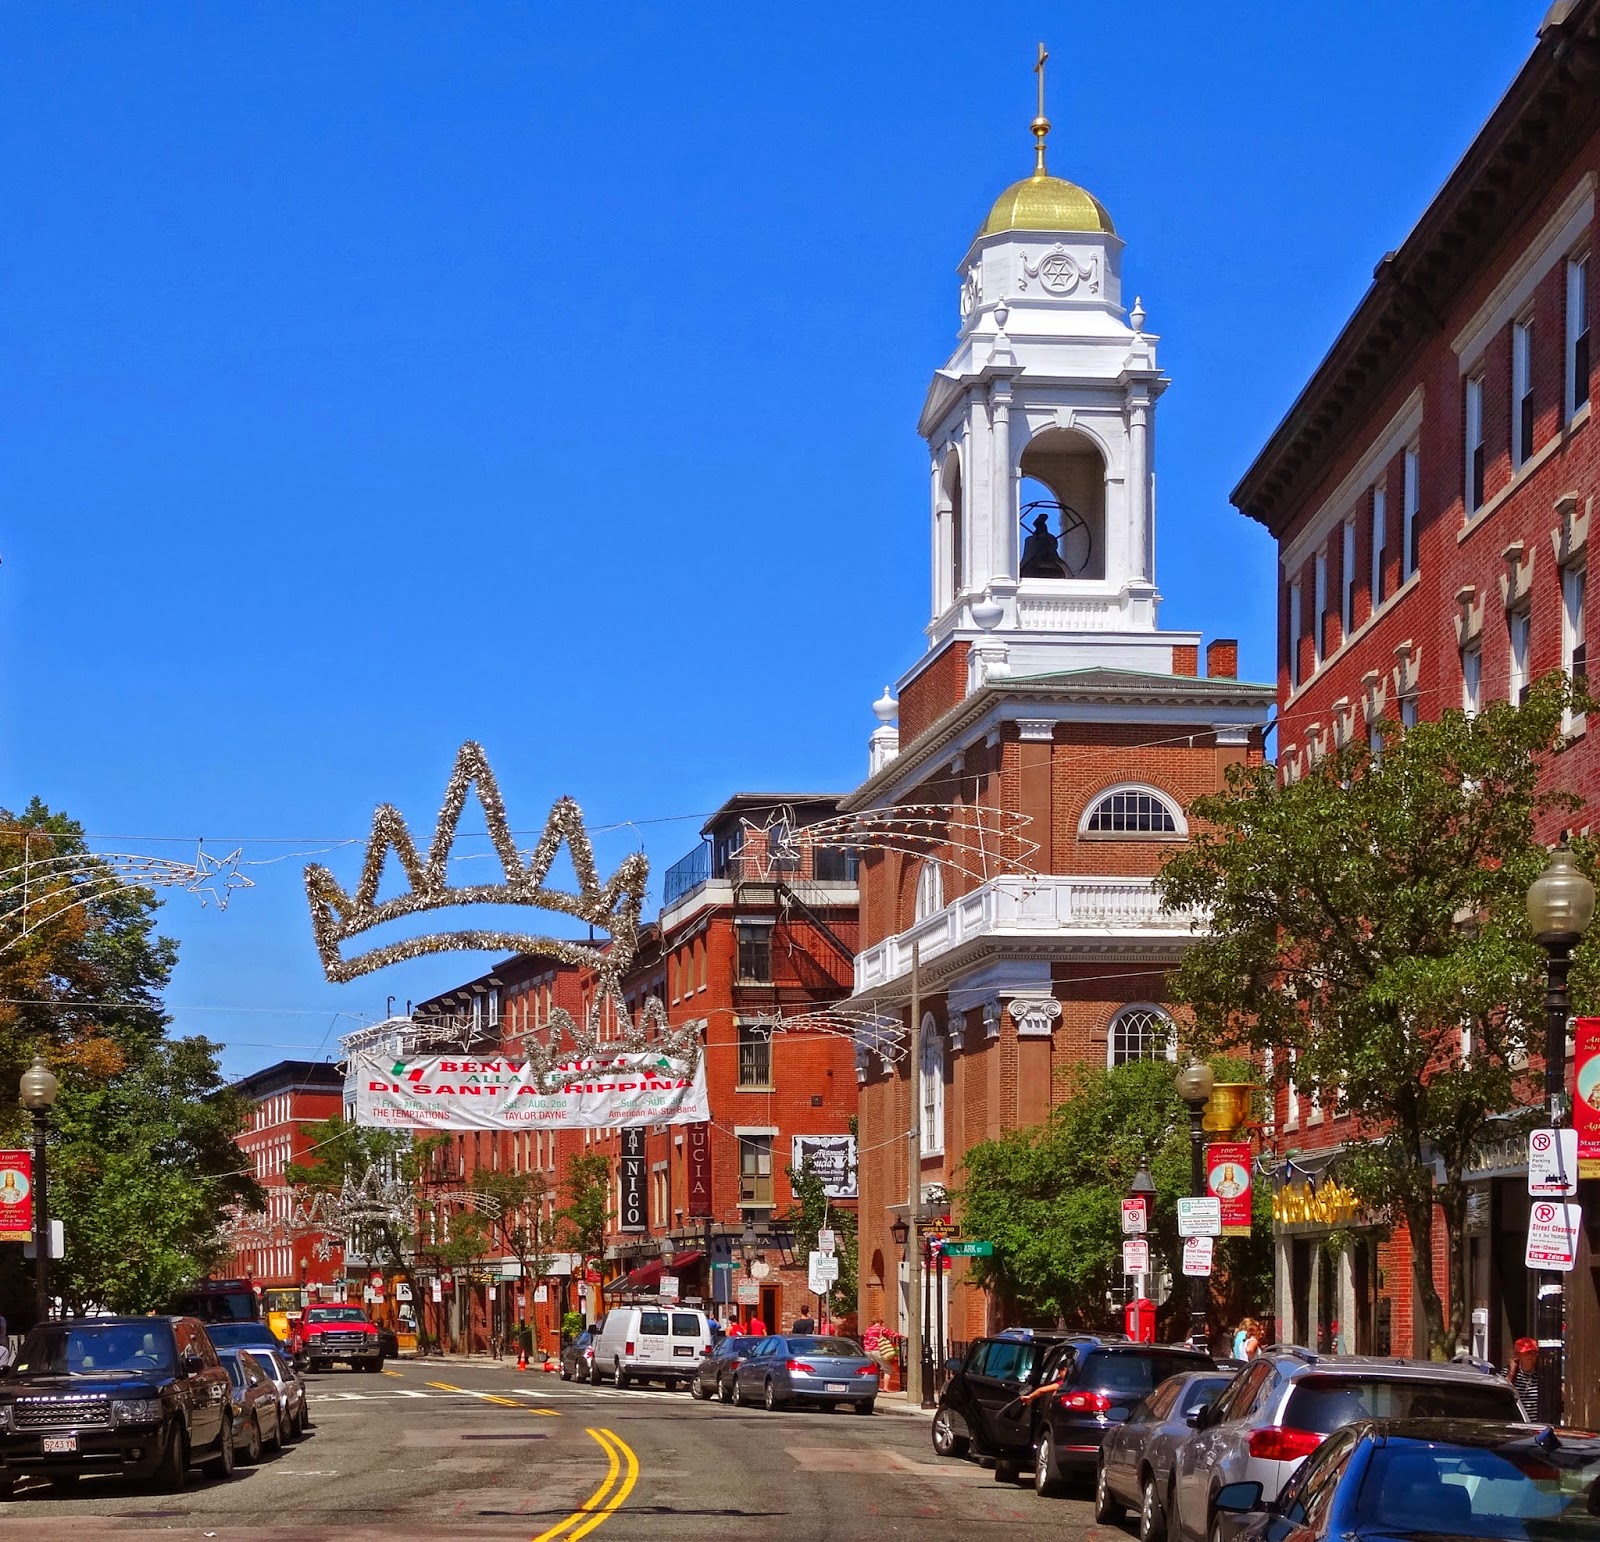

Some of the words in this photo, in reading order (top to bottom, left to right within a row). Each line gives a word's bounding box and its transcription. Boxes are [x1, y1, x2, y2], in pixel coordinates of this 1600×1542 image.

[440, 1058, 627, 1073] BENVNUTI
[466, 1075, 522, 1083] ALLA
[369, 1082, 400, 1093] DI
[428, 1101, 441, 1110] 1st
[528, 1100, 549, 1108] AUG.
[551, 1099, 567, 1108] 2nd
[372, 1108, 390, 1117] THE
[391, 1109, 450, 1120] TEMPTATIONS
[504, 1111, 537, 1120] TAYLOR
[539, 1111, 567, 1119] DAYNE
[608, 1109, 646, 1118] American
[647, 1107, 676, 1116] All-Star
[677, 1104, 697, 1114] Band
[626, 1161, 640, 1223] NICO
[1532, 1224, 1550, 1232] Street
[1552, 1225, 1576, 1235] Cleaning
[956, 1244, 977, 1253] CLARK
[66, 1440, 76, 1448] YN
